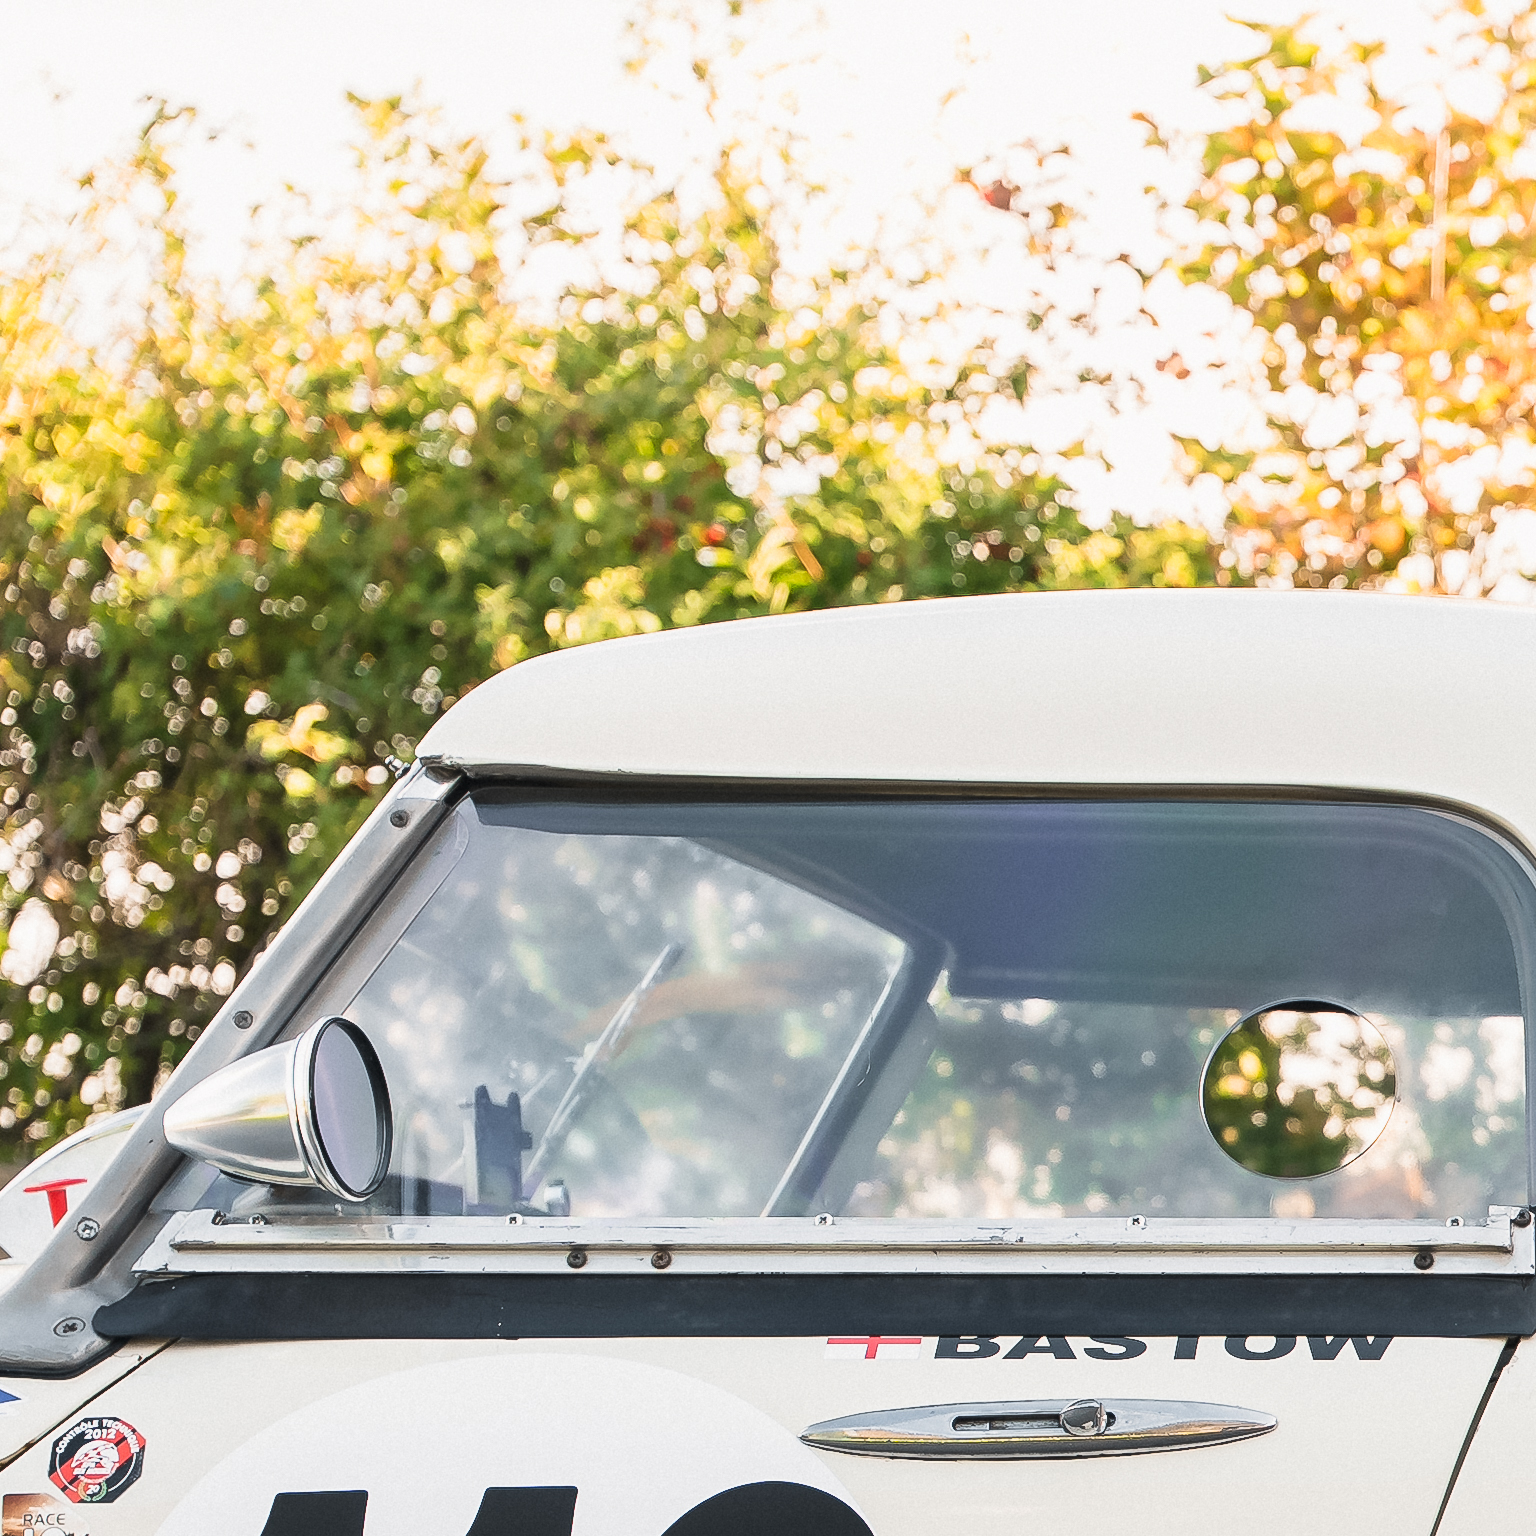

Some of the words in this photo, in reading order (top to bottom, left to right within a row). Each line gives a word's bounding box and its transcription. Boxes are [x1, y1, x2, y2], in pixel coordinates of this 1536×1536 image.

[83, 1428, 117, 1440] 2012
[86, 1484, 101, 1495] 20
[22, 1512, 66, 1526] RACE
